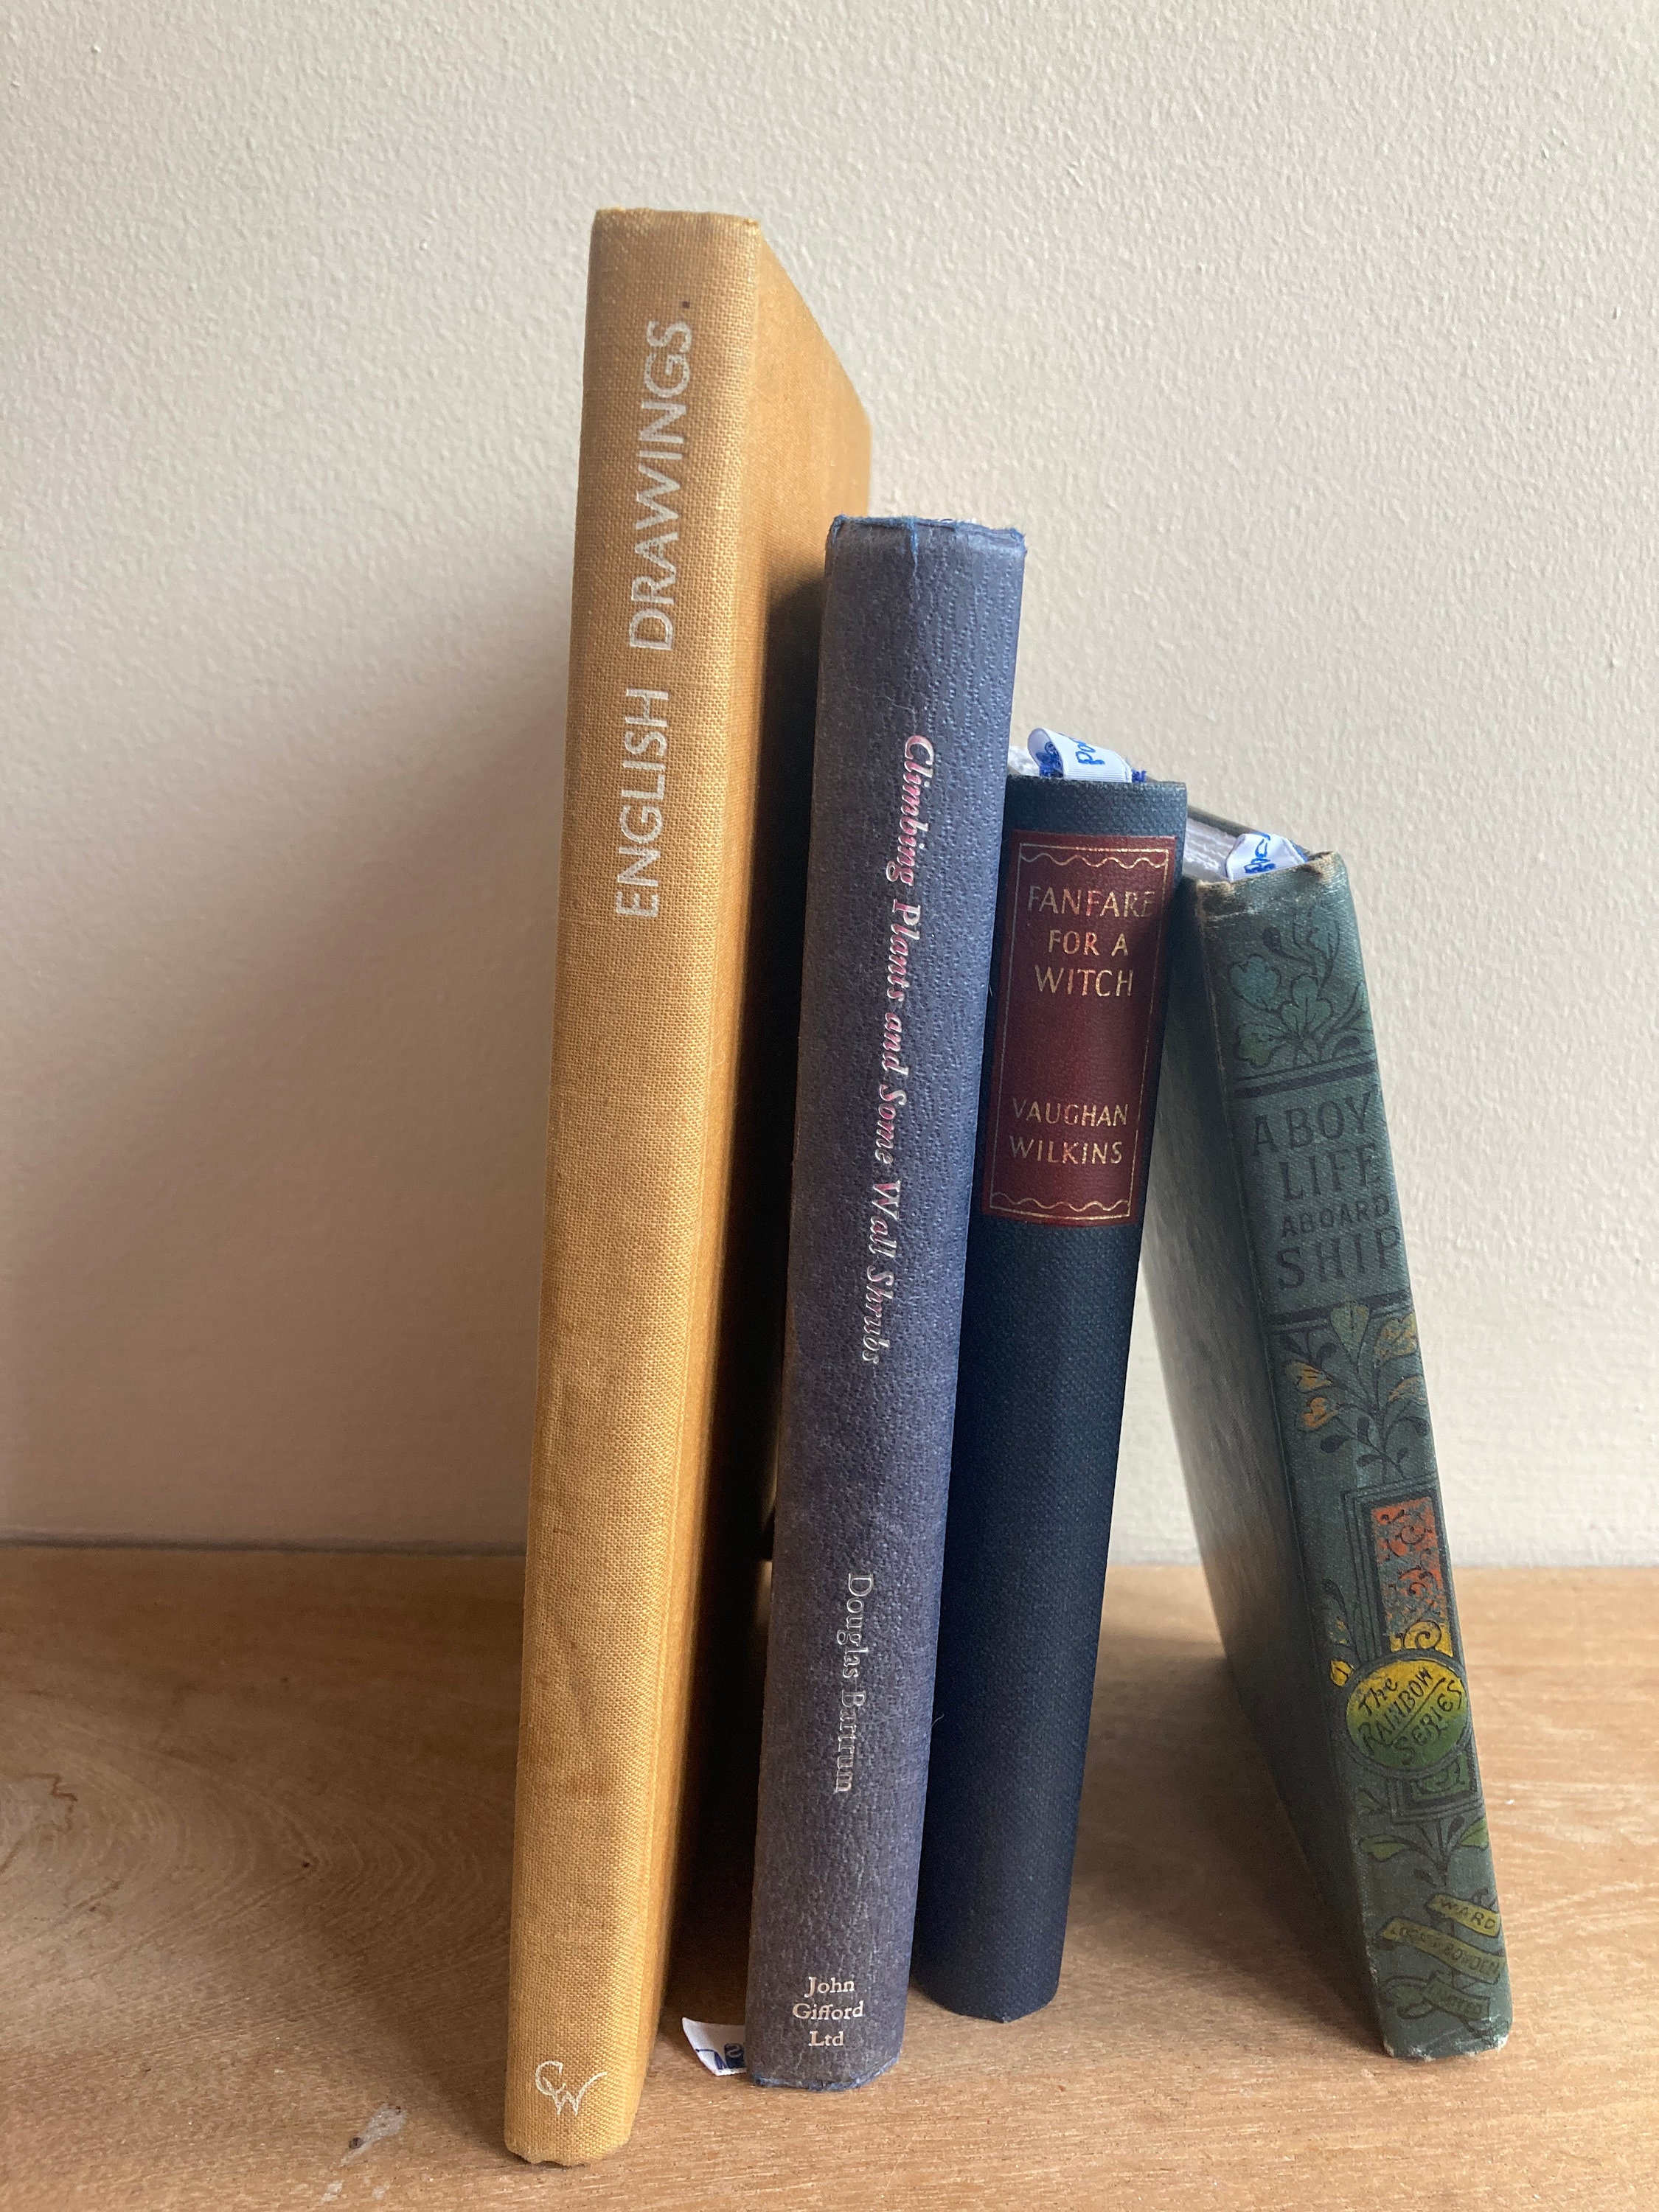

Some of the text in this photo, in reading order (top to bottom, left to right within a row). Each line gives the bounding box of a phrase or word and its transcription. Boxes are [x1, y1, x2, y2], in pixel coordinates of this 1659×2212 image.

[616, 319, 693, 919] ENGLISH DRAWINGS
[1027, 885, 1156, 917] FANFARE
[1048, 929, 1129, 956] FOR A
[1034, 964, 1134, 997] WITCH
[862, 734, 935, 1365] Climbing Plants and Some Wall Shrubs
[1012, 1097, 1129, 1127] VAUGHAN
[1009, 1135, 1123, 1165] WILKINS
[1251, 1113, 1280, 1157] A
[1279, 1143, 1382, 1202] LIFE
[1282, 1195, 1391, 1239] ABOARD
[1277, 1225, 1400, 1290] SHIP
[834, 1573, 874, 1793] Douglas Bartrum
[1358, 1667, 1433, 1756] RAINBOW
[1394, 1678, 1464, 1765] SERIES
[1440, 1900, 1497, 1930] WARD
[804, 1976, 855, 1997] John
[792, 2000, 864, 2021] Gifford
[808, 2031, 844, 2047] Ltd
